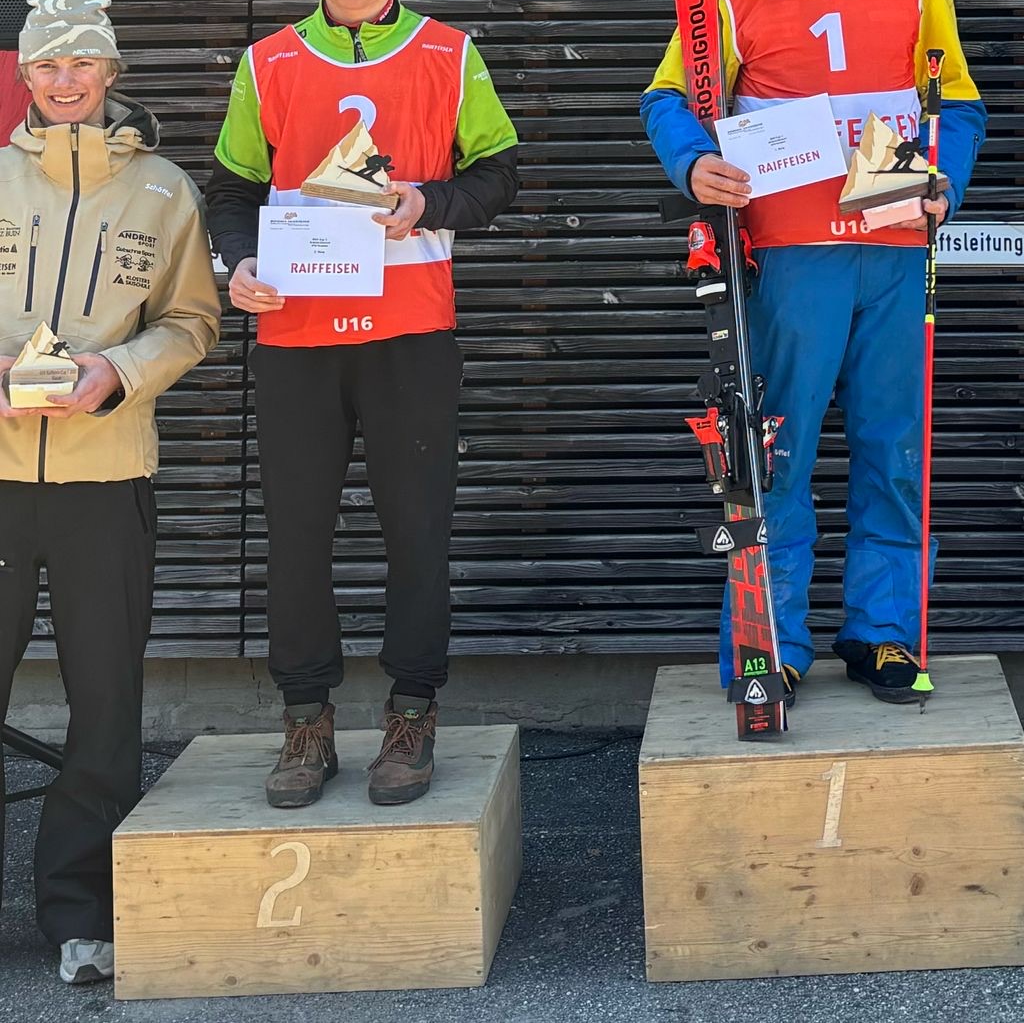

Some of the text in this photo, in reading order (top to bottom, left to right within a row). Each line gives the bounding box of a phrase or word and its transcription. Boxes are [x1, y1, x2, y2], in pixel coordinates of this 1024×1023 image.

[809, 12, 847, 72] 1
[757, 150, 821, 175] RAIFFEISEN
[118, 232, 158, 244] ANDRIST
[935, 232, 1024, 257] ftsleitung
[290, 262, 360, 274] RAIFFEISEN
[333, 316, 373, 333] U16
[744, 657, 766, 672] A13
[815, 760, 849, 848] 1
[256, 841, 312, 928] 2
